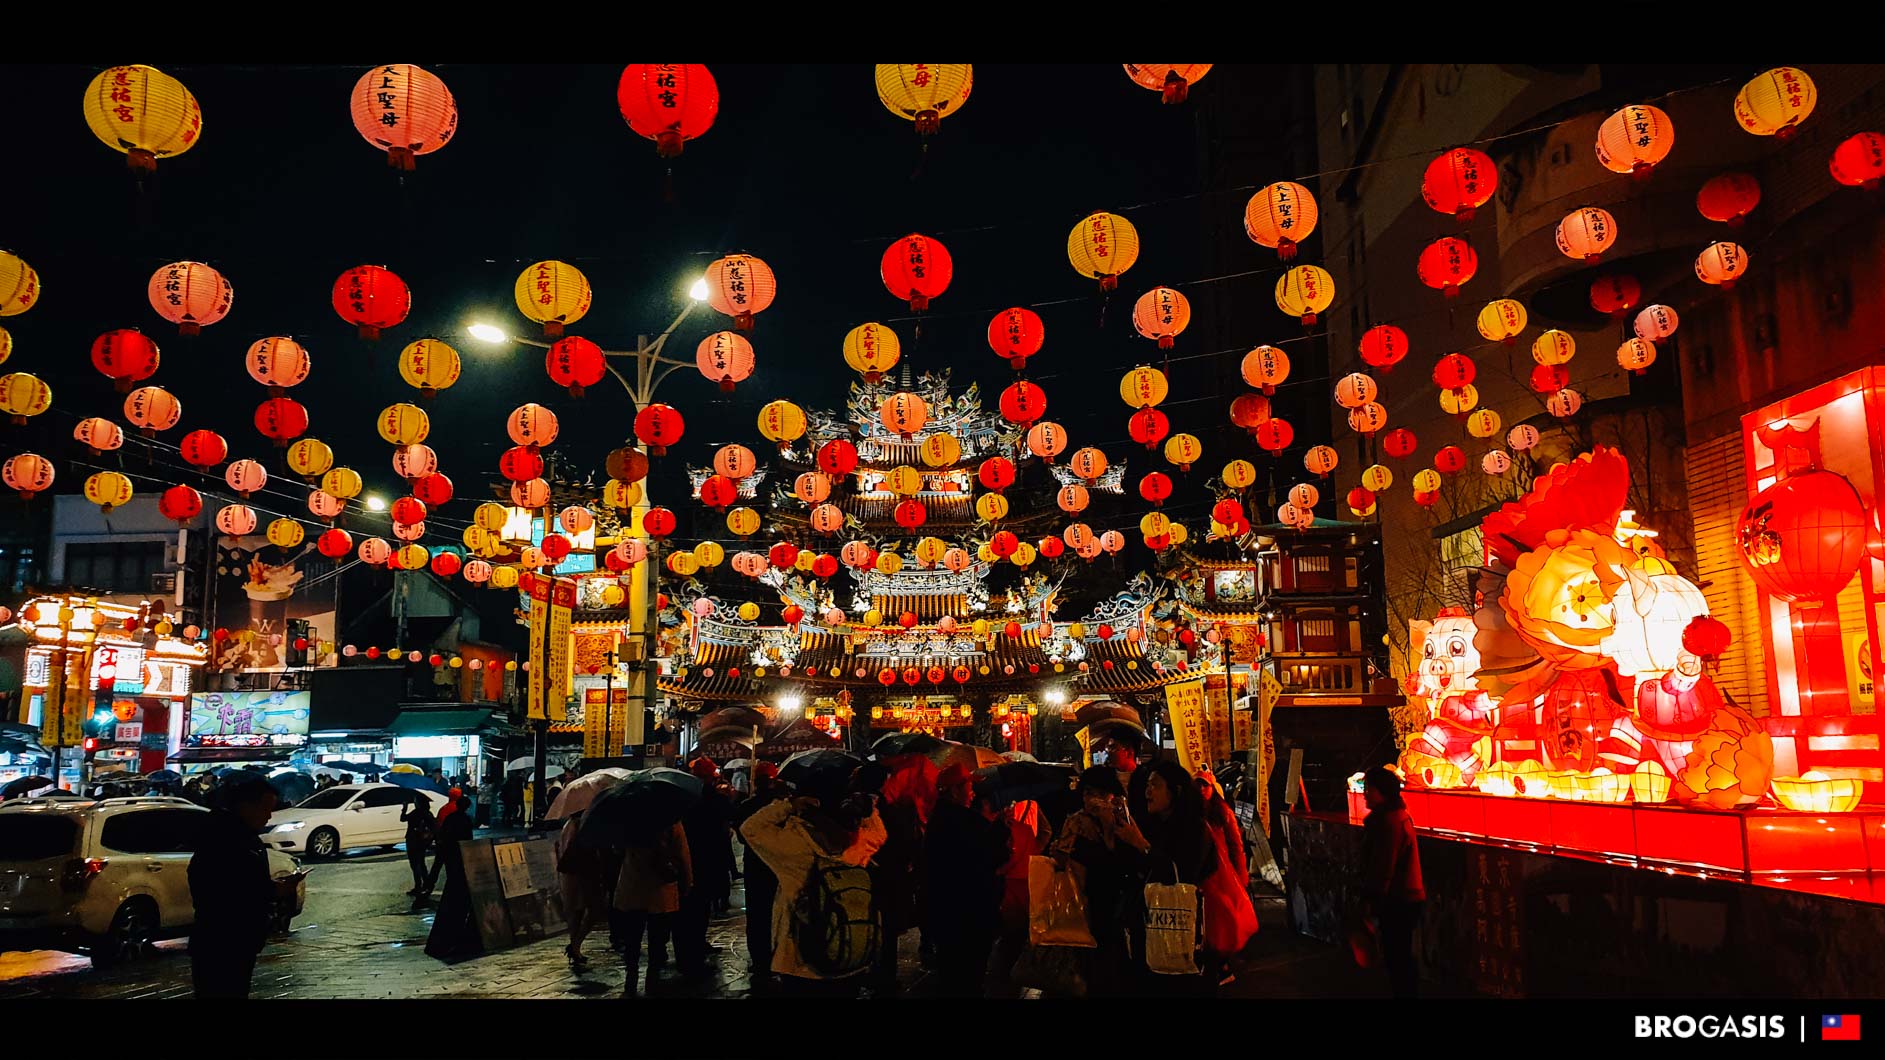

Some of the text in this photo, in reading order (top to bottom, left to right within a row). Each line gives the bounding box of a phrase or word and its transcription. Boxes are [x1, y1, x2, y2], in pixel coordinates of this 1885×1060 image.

[1276, 184, 1294, 229] 天上聖母
[1091, 221, 1108, 257] 慈祐宮
[909, 243, 925, 278] 慈祐宮
[536, 263, 554, 306] 天上聖母
[729, 268, 747, 304] 慈祐宮
[1160, 289, 1174, 324] 天上聖母
[714, 334, 726, 370] 天上聖母
[863, 325, 875, 360] 天上聖母
